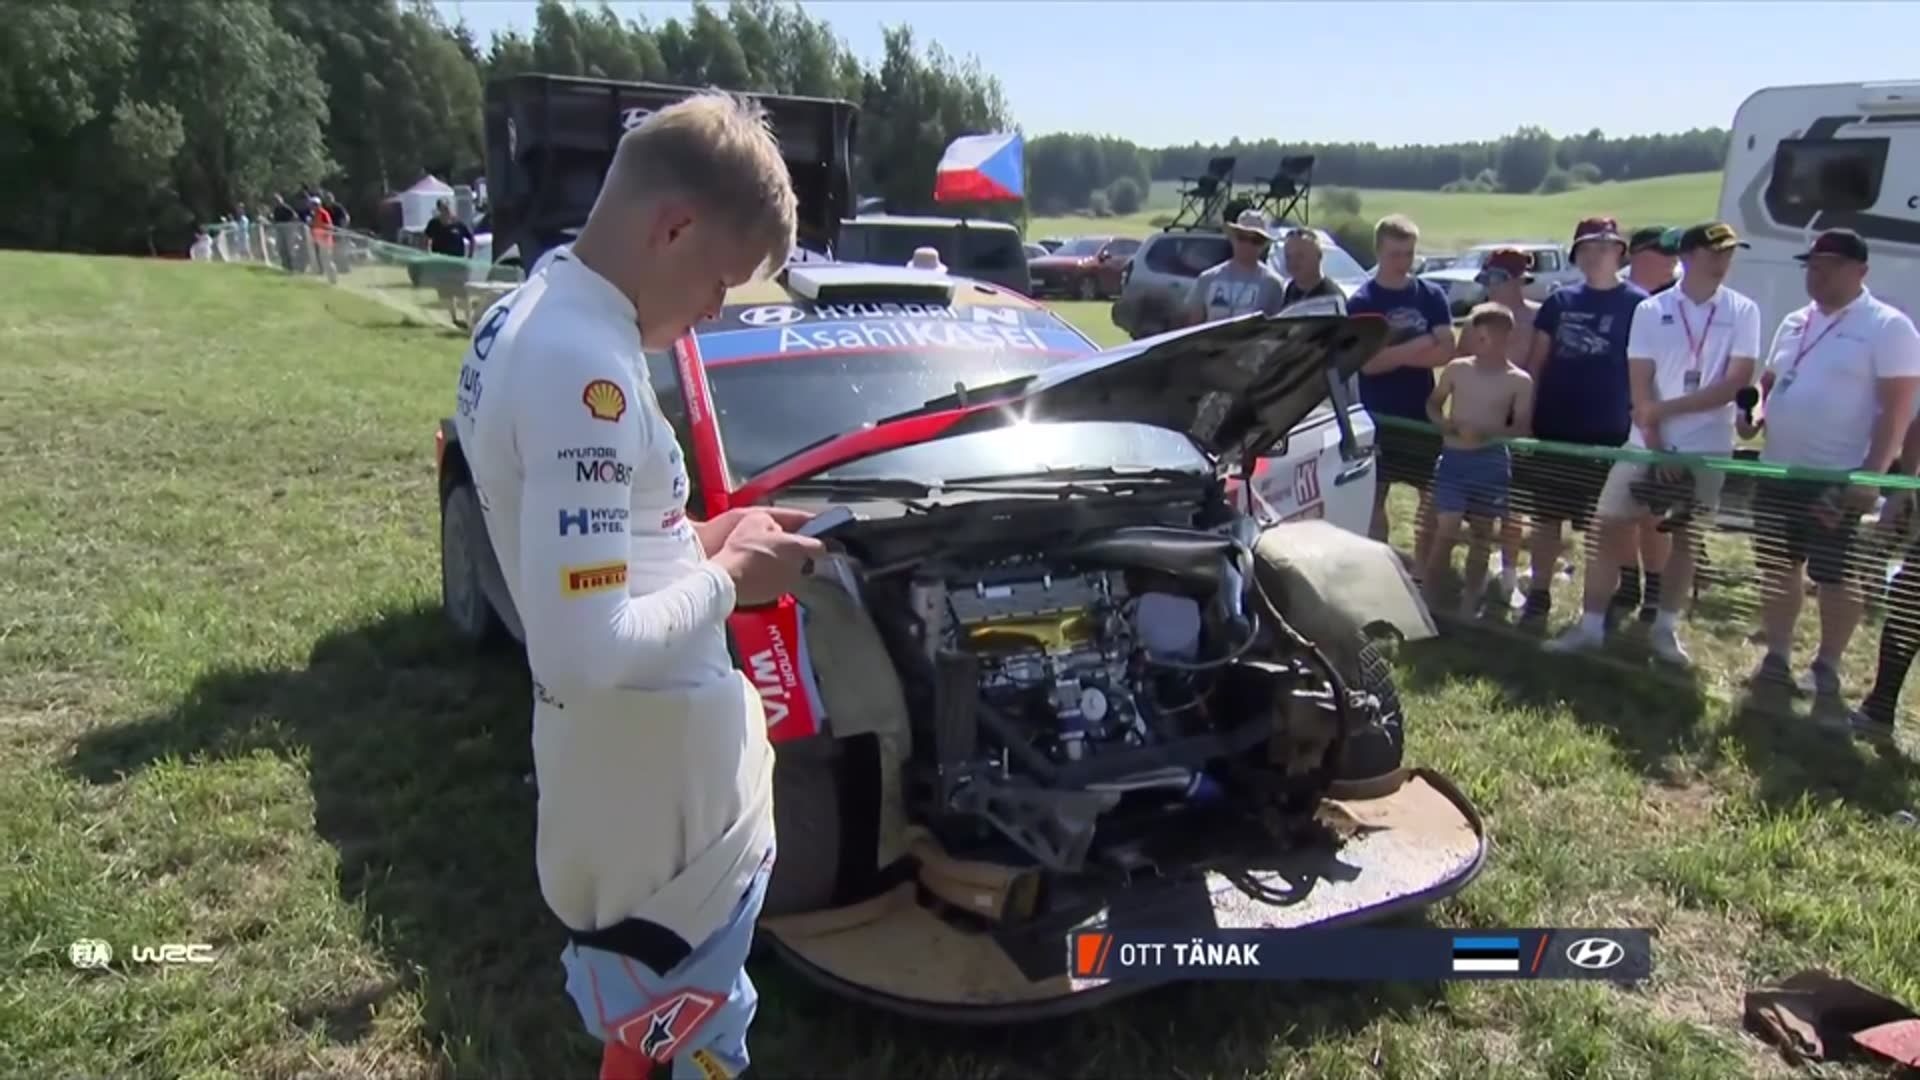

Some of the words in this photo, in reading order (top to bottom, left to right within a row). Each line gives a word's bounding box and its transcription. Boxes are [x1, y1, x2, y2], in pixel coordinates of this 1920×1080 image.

[814, 302, 959, 320] HYUNDAI
[591, 521, 625, 534] STEEL
[767, 624, 797, 688] HYUNDAI
